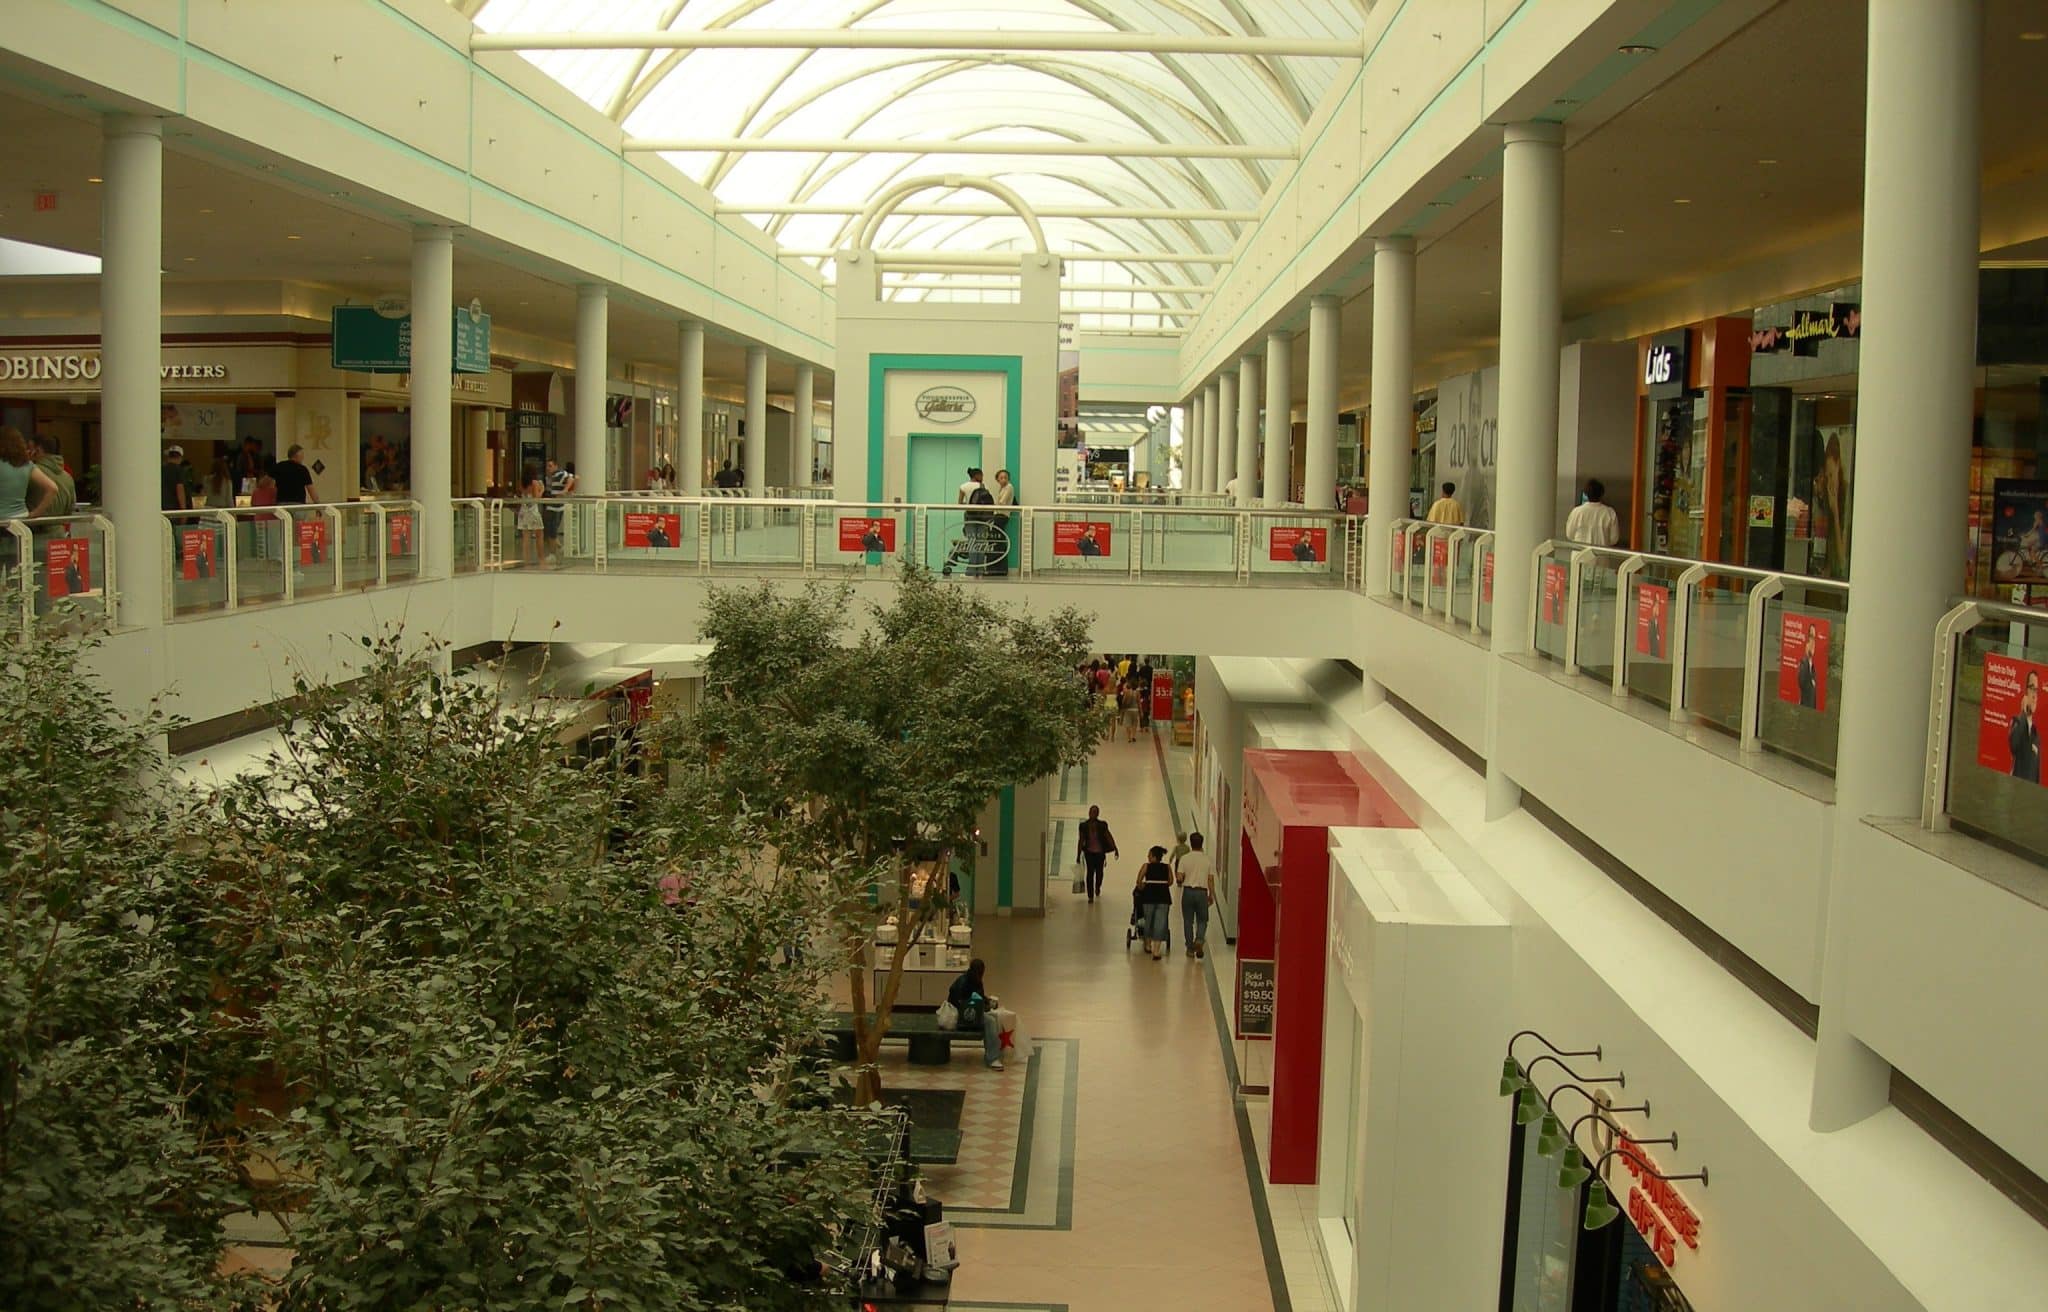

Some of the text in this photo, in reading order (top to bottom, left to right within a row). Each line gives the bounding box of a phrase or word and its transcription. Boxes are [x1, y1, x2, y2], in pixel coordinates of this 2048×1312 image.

[1785, 304, 1840, 351] Hallmark
[1645, 345, 1671, 384] Lids
[920, 400, 965, 417] Galleria
[1245, 971, 1262, 980] Solid
[1245, 980, 1265, 988] Pique
[1629, 1186, 1676, 1267] GIFTS
